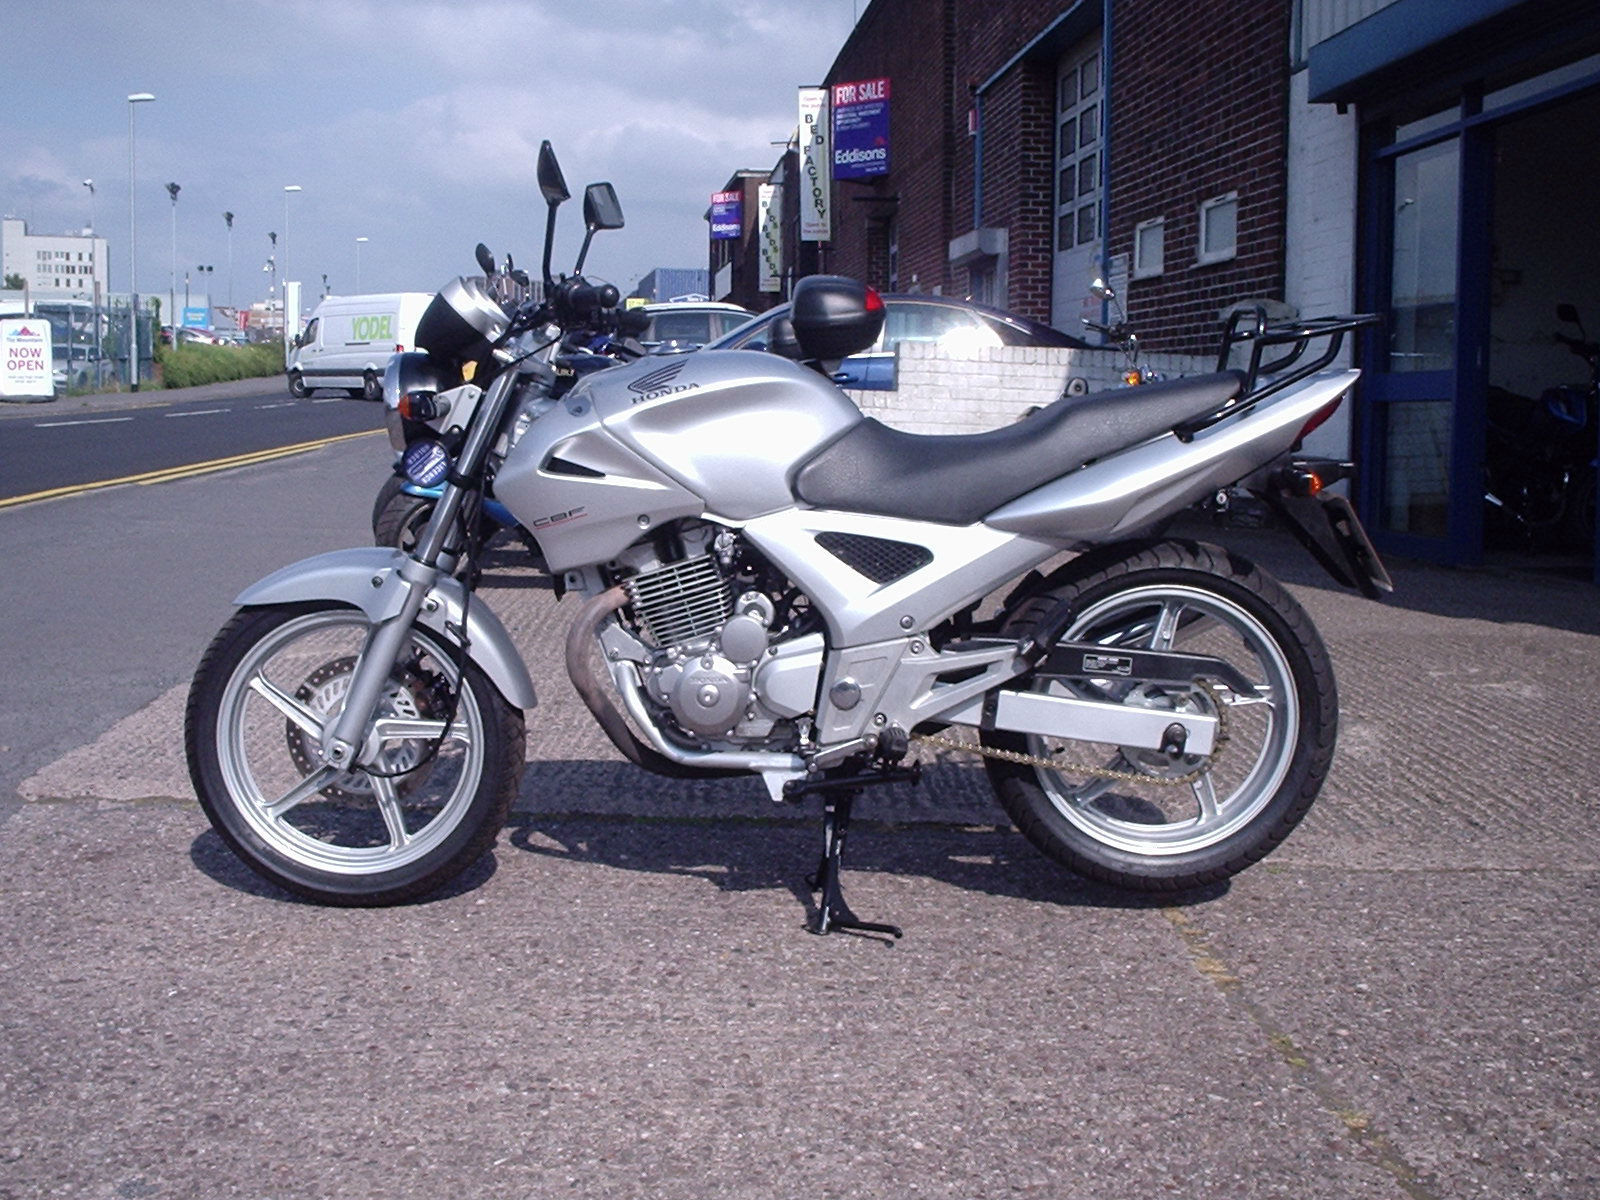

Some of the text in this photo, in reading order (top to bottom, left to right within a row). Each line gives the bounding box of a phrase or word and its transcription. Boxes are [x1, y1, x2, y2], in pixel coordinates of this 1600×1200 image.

[836, 80, 885, 104] FOR SALE
[804, 113, 825, 145] BED
[835, 148, 886, 164] Eddisons
[803, 145, 827, 218] FACTORY
[352, 315, 393, 340] YODEL
[9, 347, 42, 358] NOW
[7, 360, 44, 371] OPEN
[631, 382, 700, 405] HONDA
